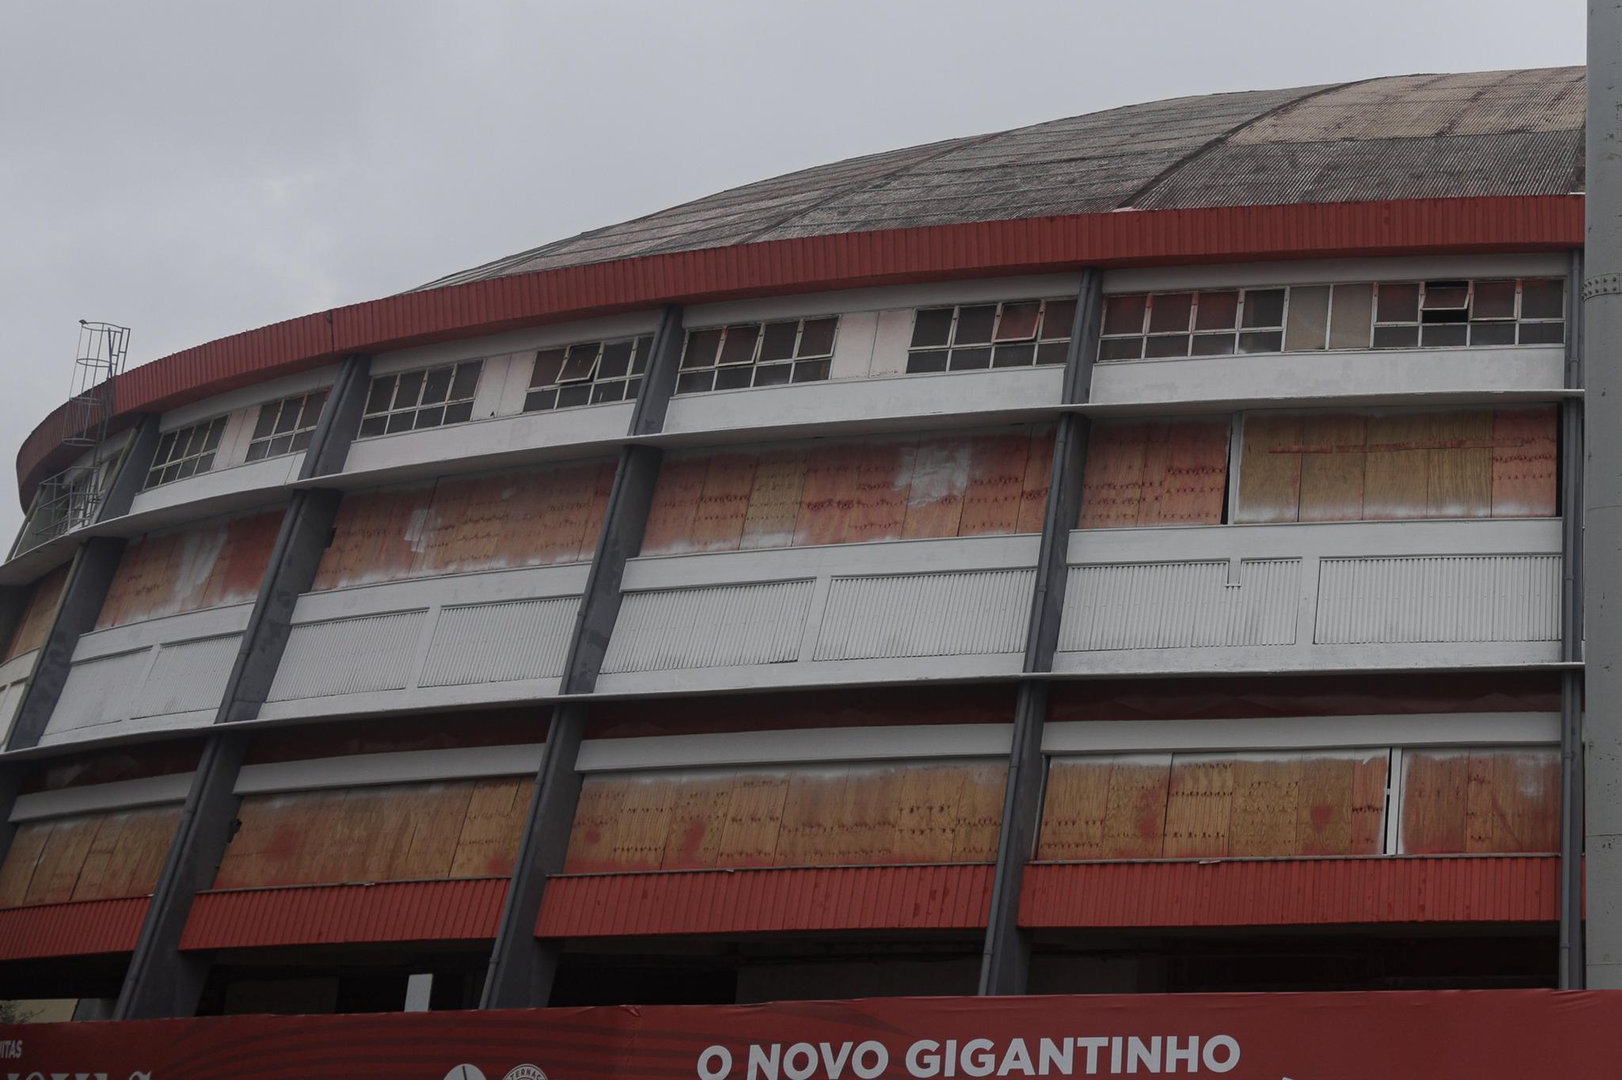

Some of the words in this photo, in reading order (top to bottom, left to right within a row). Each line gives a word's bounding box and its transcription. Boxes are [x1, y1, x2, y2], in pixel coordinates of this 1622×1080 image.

[696, 1045, 733, 1080] O
[747, 1040, 889, 1080] NOVO
[904, 1035, 1241, 1078] GIGANTINHO
